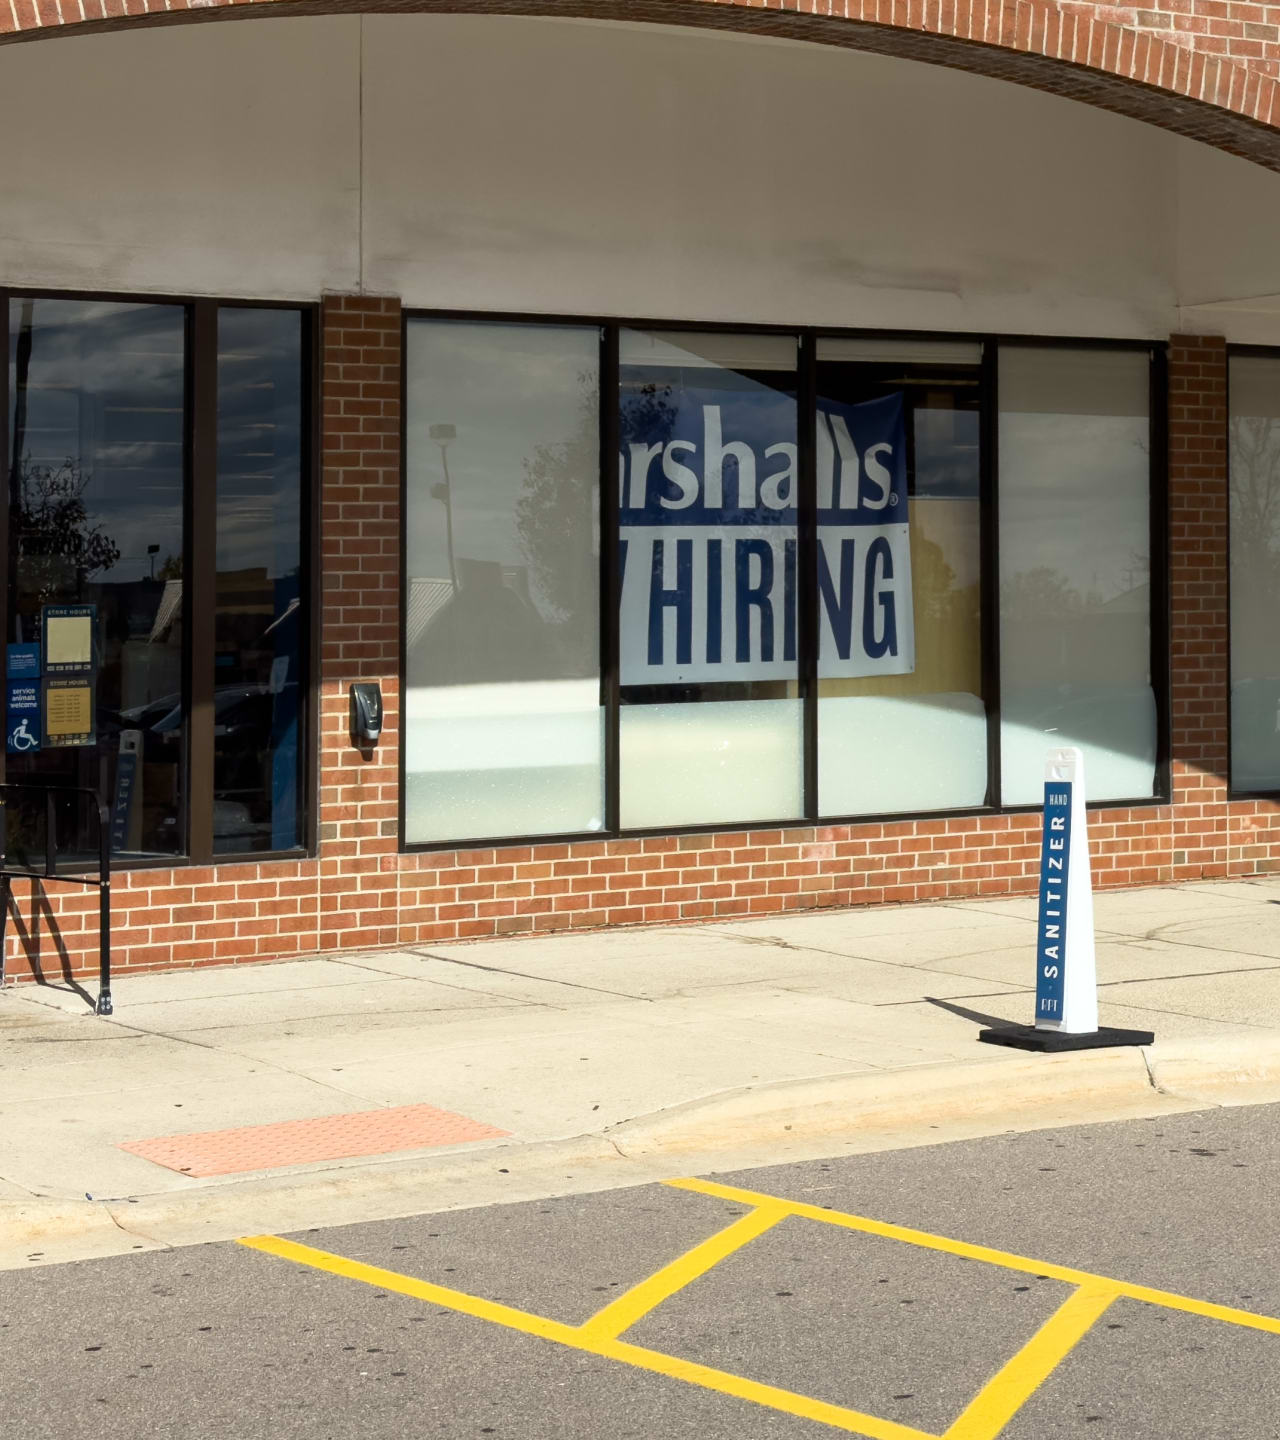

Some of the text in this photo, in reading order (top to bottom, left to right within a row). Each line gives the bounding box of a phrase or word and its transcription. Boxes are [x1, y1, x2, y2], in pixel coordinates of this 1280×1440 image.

[620, 405, 893, 510] rshalls
[648, 537, 898, 665] HIRING
[11, 694, 36, 702] animals
[1049, 794, 1068, 806] HAND
[1044, 816, 1065, 979] SANITIZER
